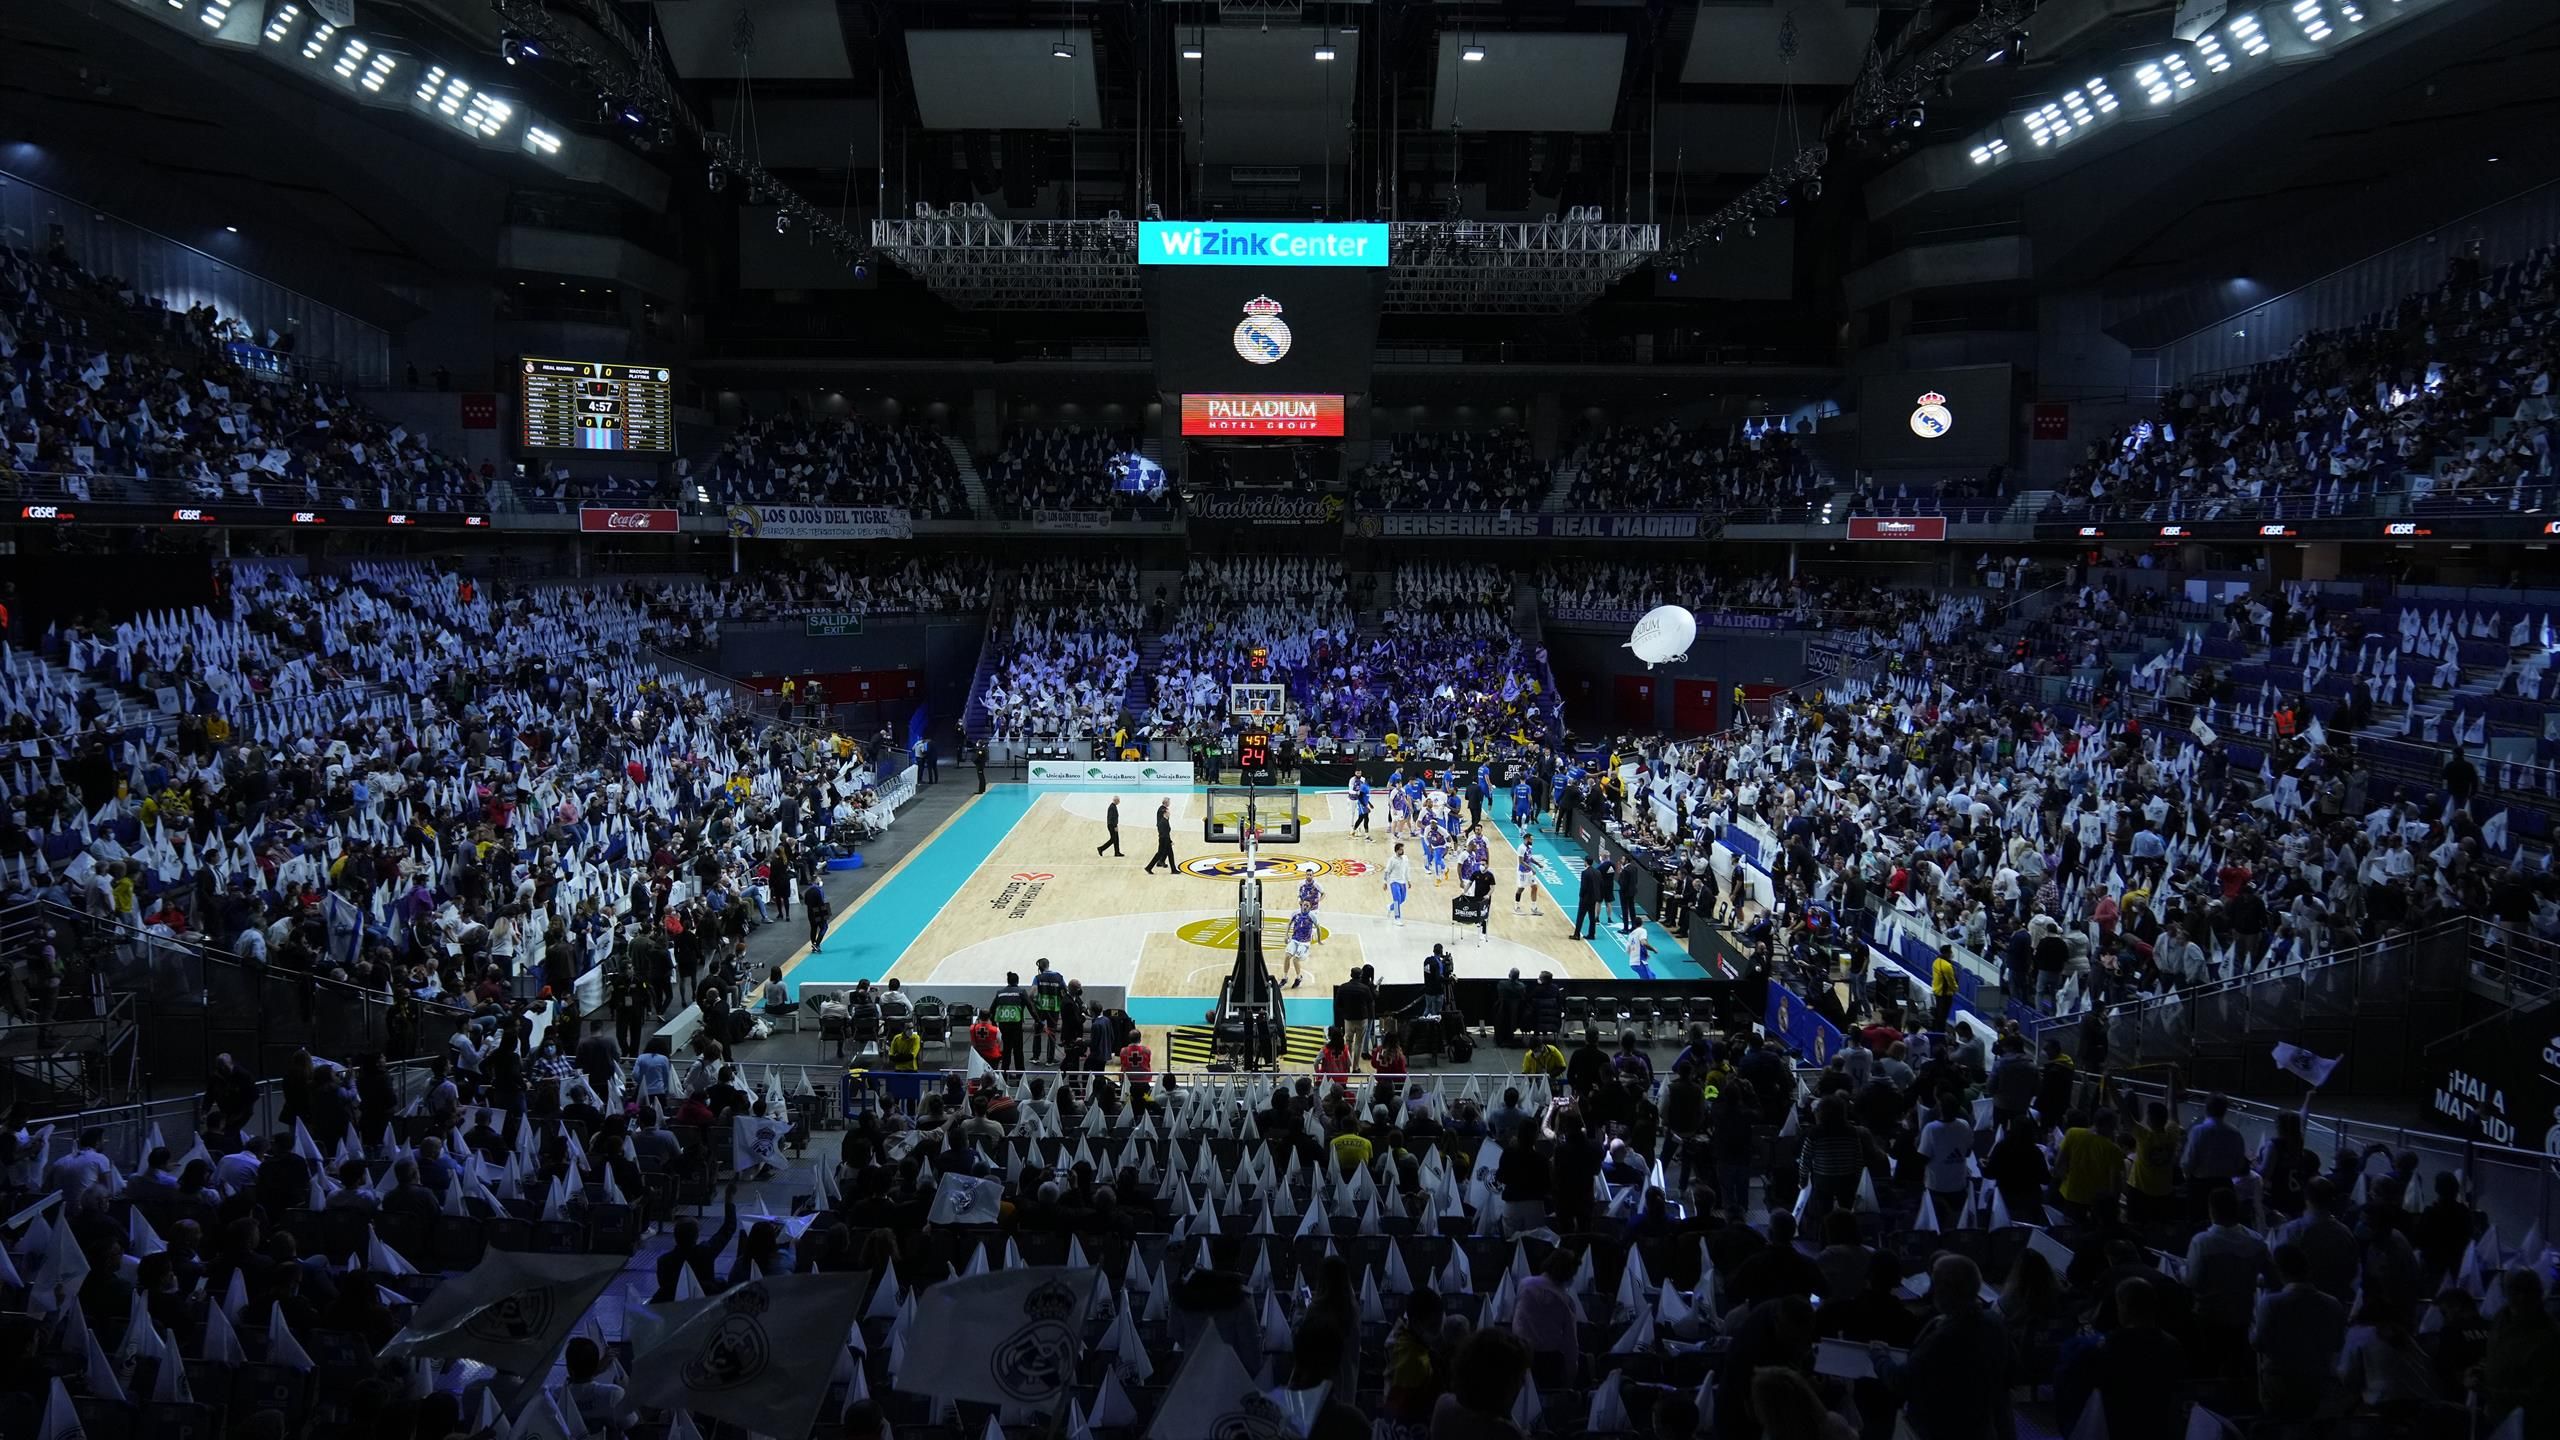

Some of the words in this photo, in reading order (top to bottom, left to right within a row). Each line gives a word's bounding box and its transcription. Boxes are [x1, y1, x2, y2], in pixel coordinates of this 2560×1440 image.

[583, 366, 591, 375] 0
[605, 368, 612, 377] 0
[588, 401, 613, 412] 4:57
[1208, 400, 1318, 417] PALLADIUM
[585, 419, 593, 427] 0
[1209, 421, 1256, 429] HOTEL
[1266, 421, 1318, 429] GROUP
[1187, 493, 1330, 520] Madridistas
[761, 508, 786, 523] LOS
[789, 509, 822, 523] OJOS
[825, 510, 850, 524] DEL
[851, 511, 889, 524] TIGRE
[1048, 512, 1058, 522] LOS
[1383, 515, 1539, 536] BERSERKERS
[1551, 516, 1606, 537] REAL
[1610, 516, 1697, 538] MADRID
[809, 615, 859, 626] SALIDA
[1713, 614, 1770, 629] MADRID
[823, 626, 846, 634] EXIT
[1251, 656, 1265, 668] 24
[1241, 748, 1265, 766] 24
